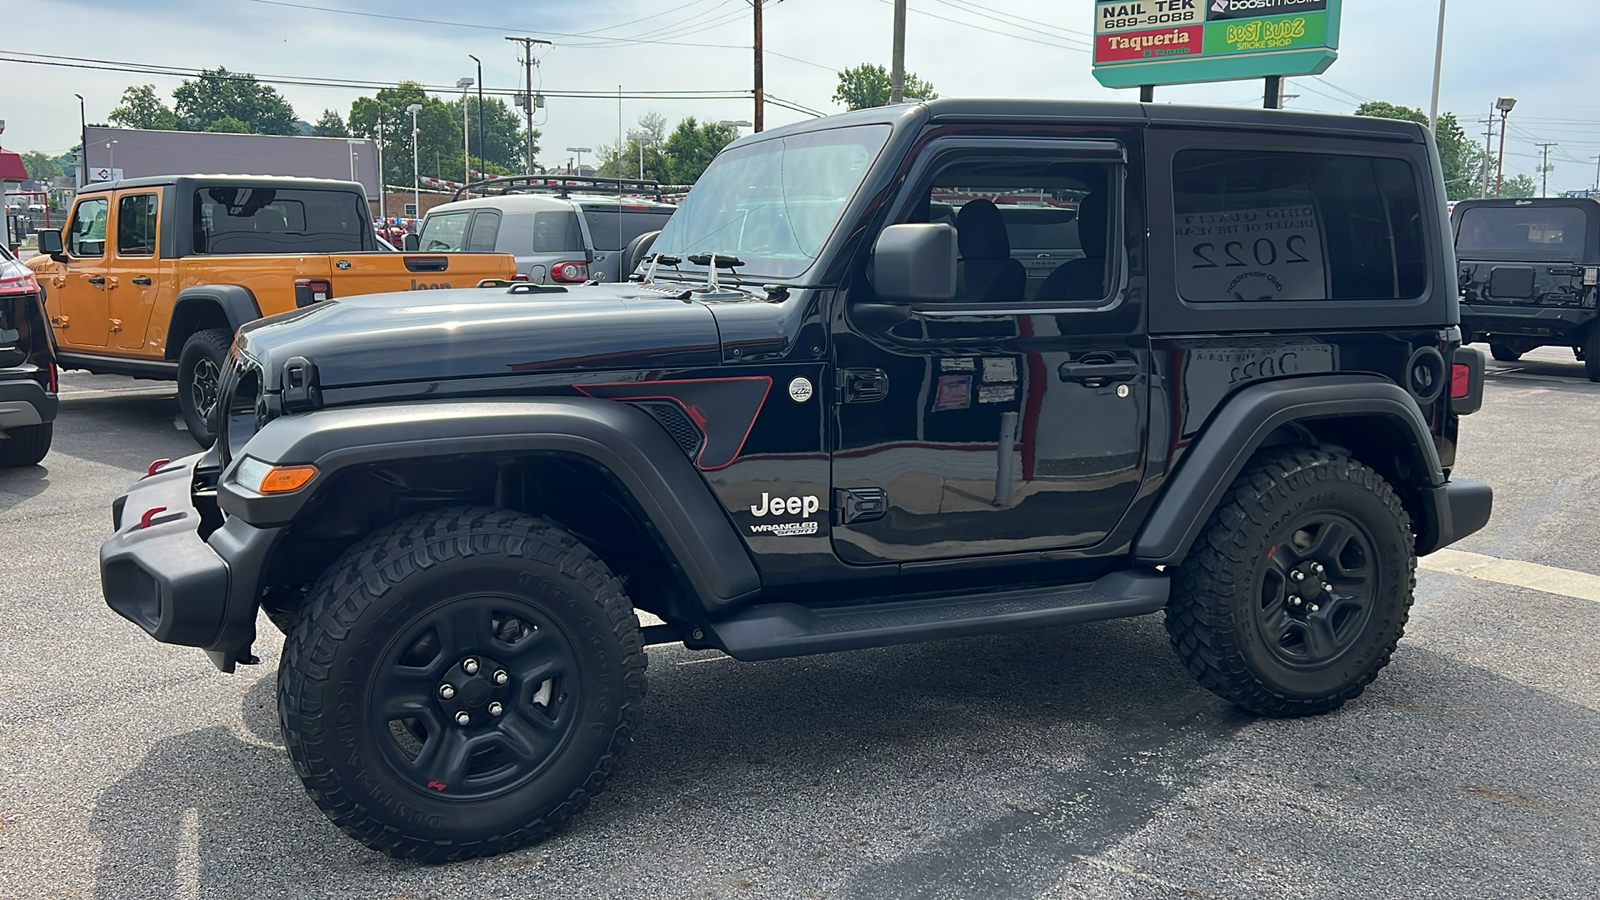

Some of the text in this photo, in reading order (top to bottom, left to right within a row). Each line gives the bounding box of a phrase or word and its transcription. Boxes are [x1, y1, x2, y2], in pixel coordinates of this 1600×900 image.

[1103, 0, 1195, 18] NAIL TEK
[1104, 11, 1194, 29] 689-9088
[1263, 17, 1306, 41] BUDZ
[1108, 29, 1190, 51] Taqueria
[1237, 38, 1292, 50] SMOKE SHOP
[750, 492, 820, 518] Jeep
[750, 521, 818, 533] WRANGLER
